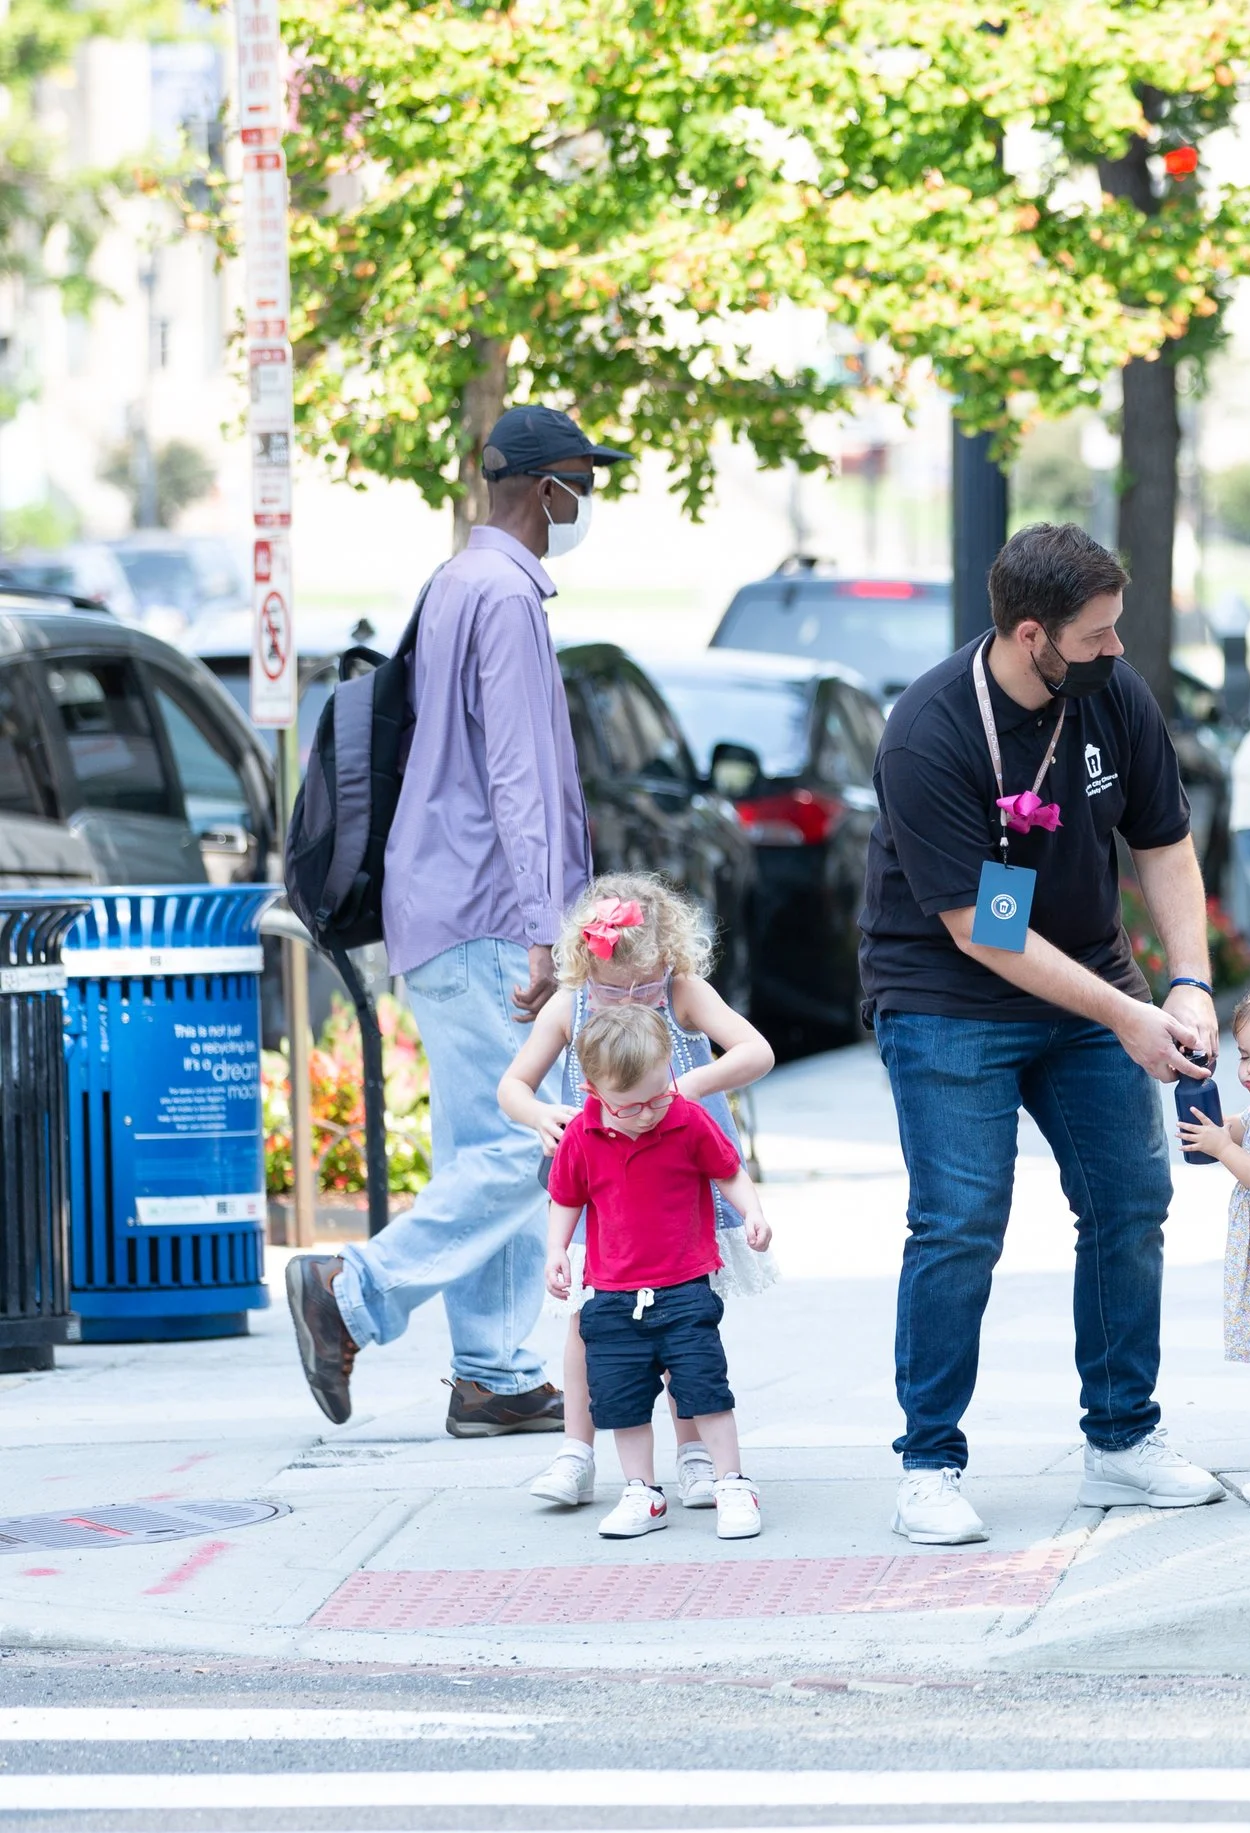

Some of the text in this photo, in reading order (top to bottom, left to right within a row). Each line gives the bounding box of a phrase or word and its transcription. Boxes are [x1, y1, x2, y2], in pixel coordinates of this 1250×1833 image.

[983, 700, 1001, 760] Union City Church
[174, 1023, 197, 1038] This
[197, 1024, 207, 1038] is
[208, 1024, 226, 1038] not
[202, 1041, 245, 1056] recycling
